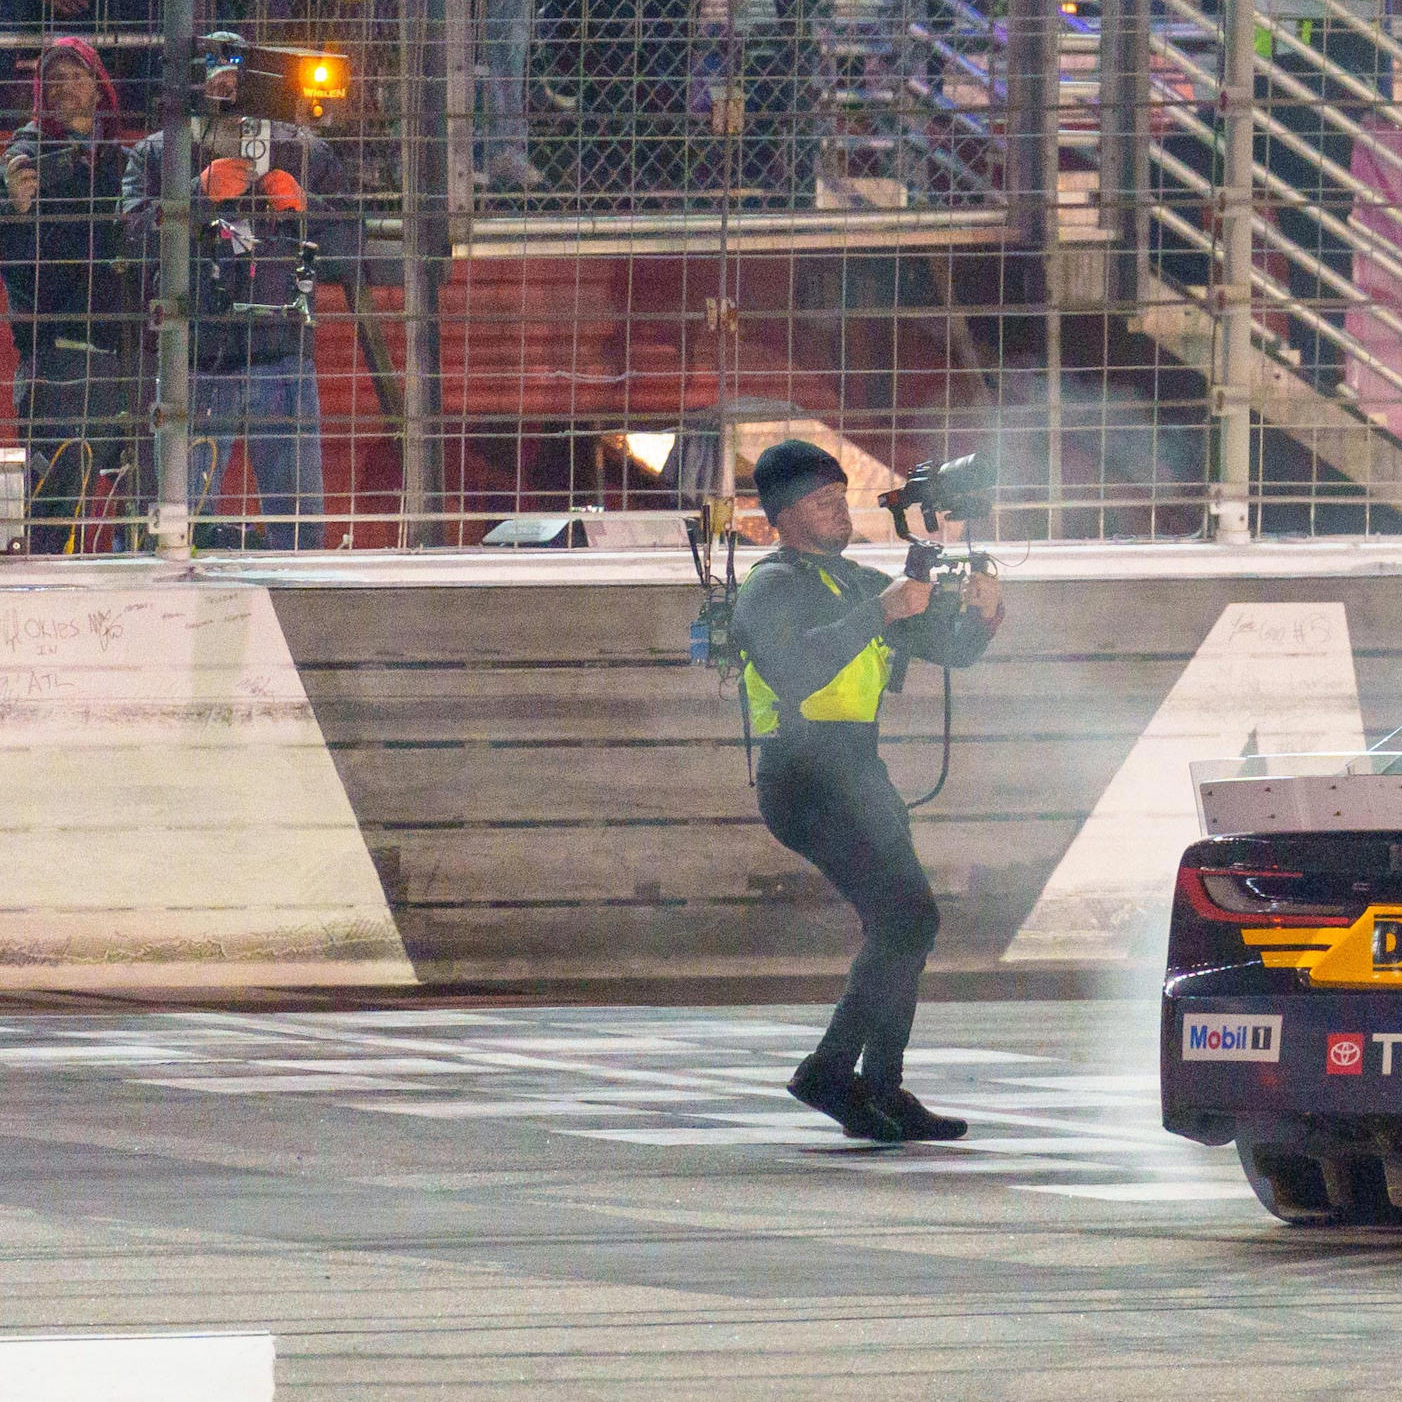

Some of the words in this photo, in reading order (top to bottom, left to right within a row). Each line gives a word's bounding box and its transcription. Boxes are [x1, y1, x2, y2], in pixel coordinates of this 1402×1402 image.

[303, 87, 346, 98] WHELEN
[1190, 1025, 1247, 1051] Mobil
[1251, 1025, 1271, 1051] 1
